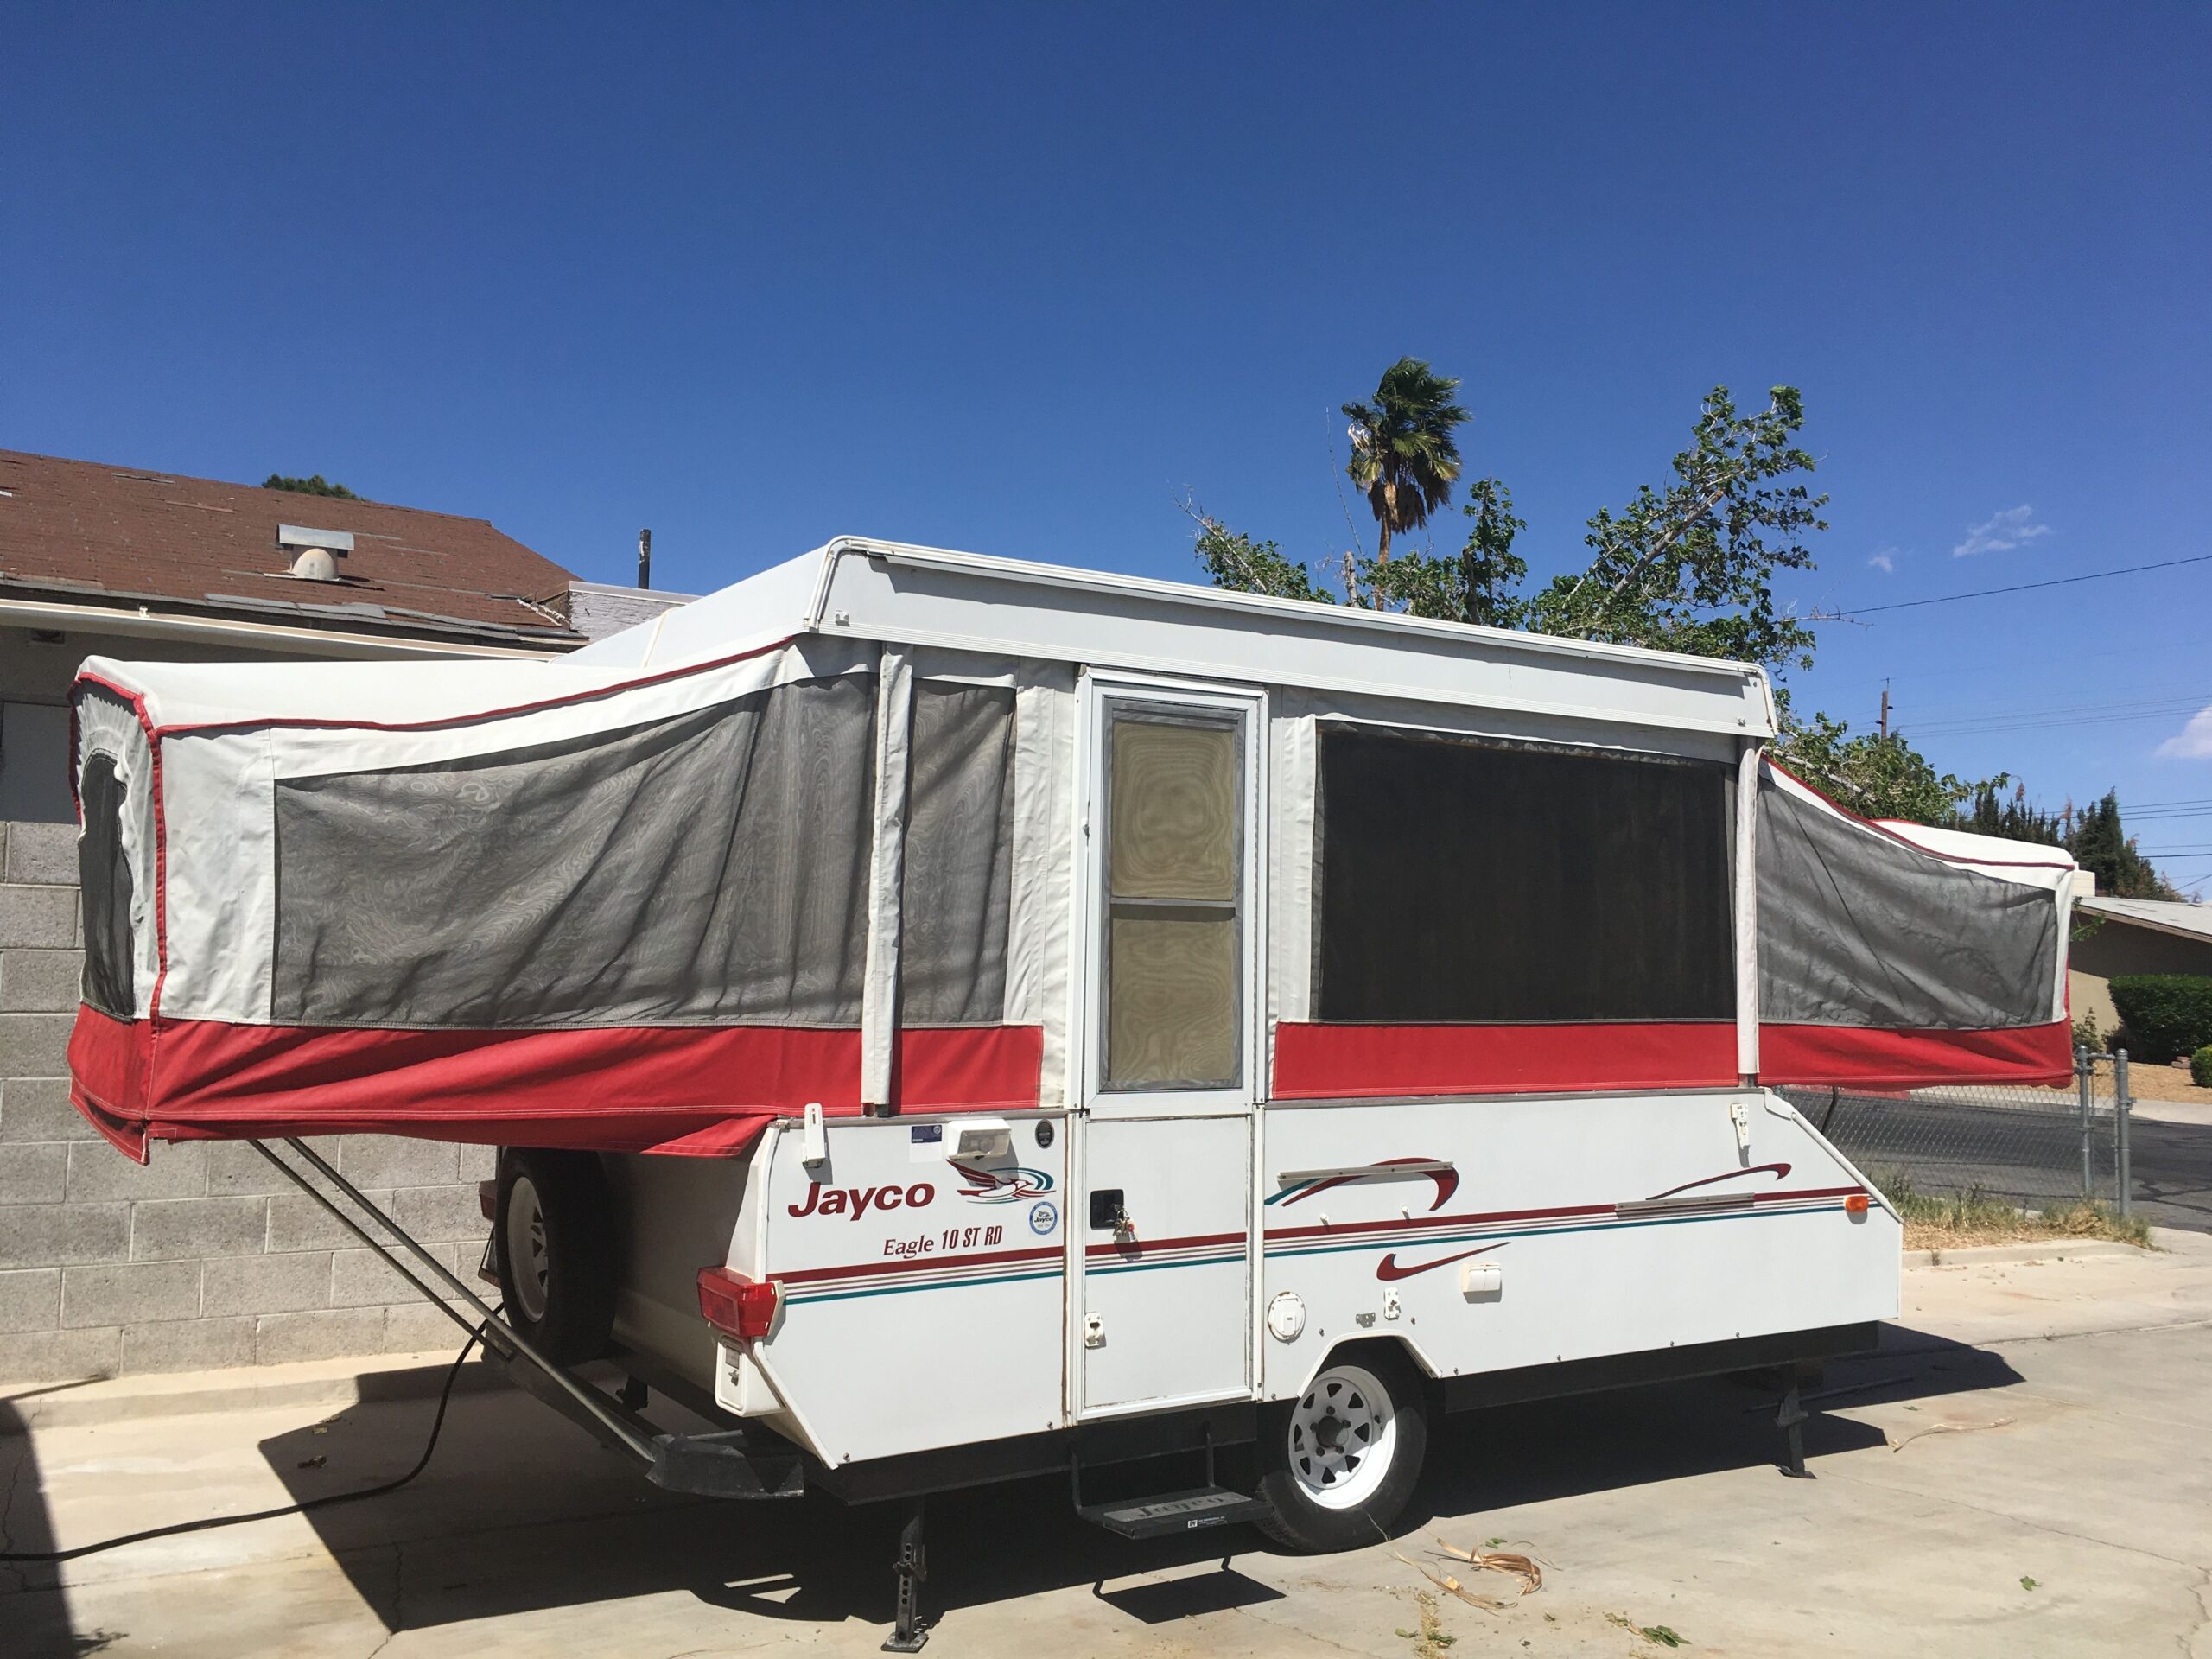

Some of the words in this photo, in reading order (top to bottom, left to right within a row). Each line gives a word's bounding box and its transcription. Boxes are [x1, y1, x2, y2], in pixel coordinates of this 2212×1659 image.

[788, 1181, 935, 1221] Jayco
[883, 1235, 933, 1259] Eagle
[942, 1230, 959, 1249] 10
[963, 1227, 981, 1249] ST
[985, 1225, 1002, 1246] RD
[1138, 1497, 1224, 1516] Jayco
